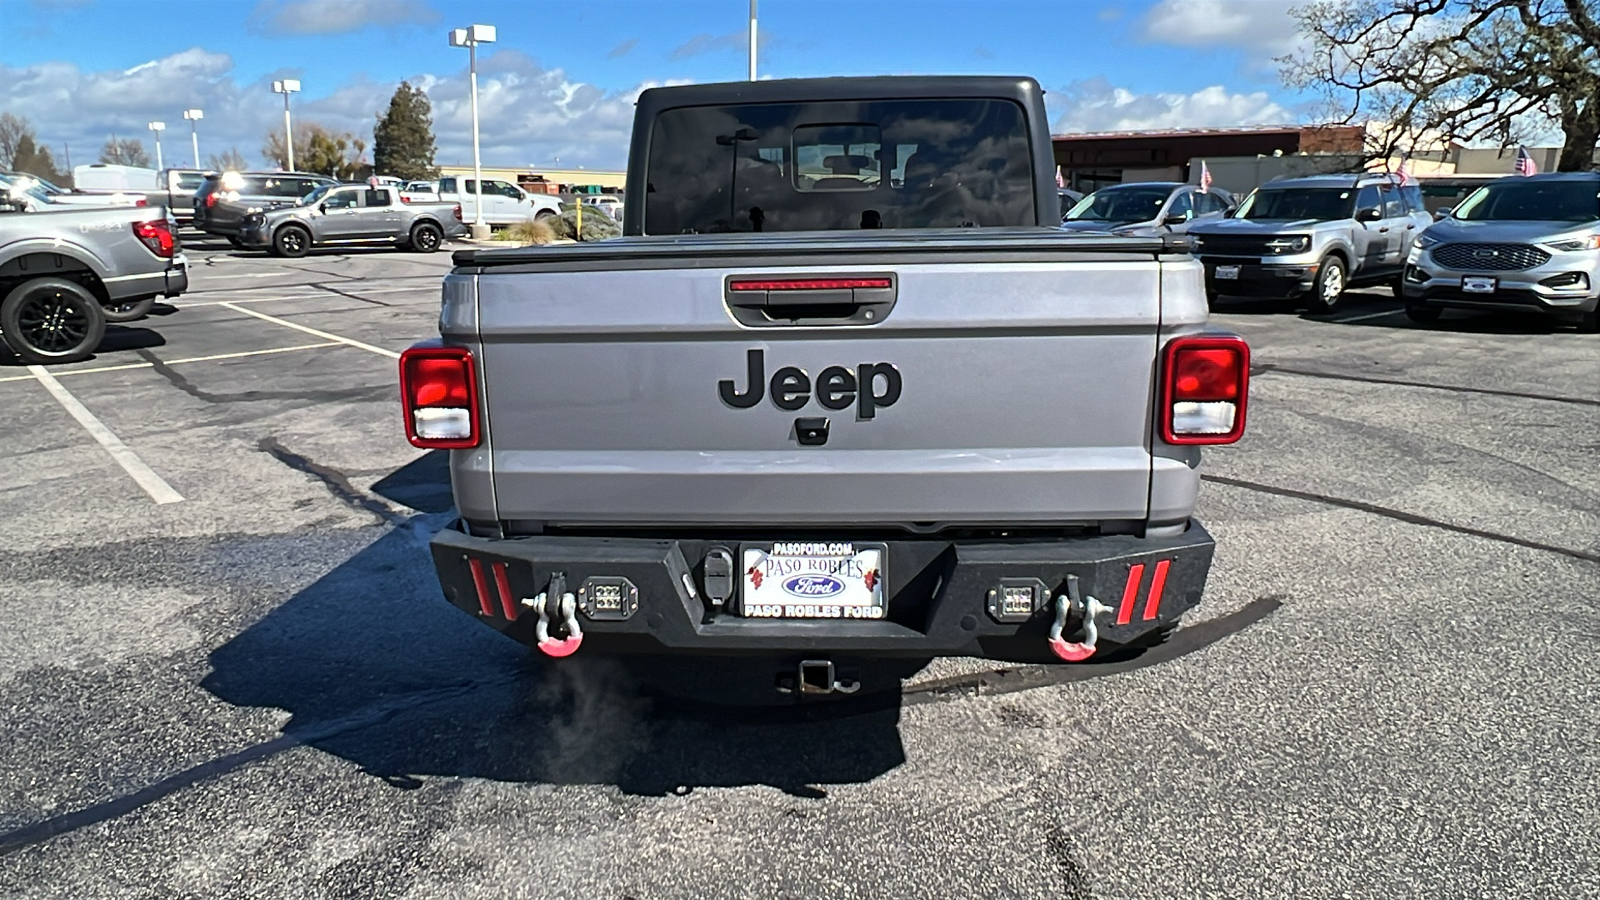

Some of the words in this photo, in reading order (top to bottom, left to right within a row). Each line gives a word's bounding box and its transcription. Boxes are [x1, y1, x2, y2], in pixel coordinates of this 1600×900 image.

[718, 349, 902, 419] Jeep
[773, 543, 853, 556] PASOFORD.COM
[765, 559, 801, 578] PASO
[808, 559, 863, 579] ROBLES
[794, 577, 834, 595] Ford
[744, 605, 783, 618] PASO
[785, 605, 841, 618] ROBLES
[843, 606, 883, 619] FORD
